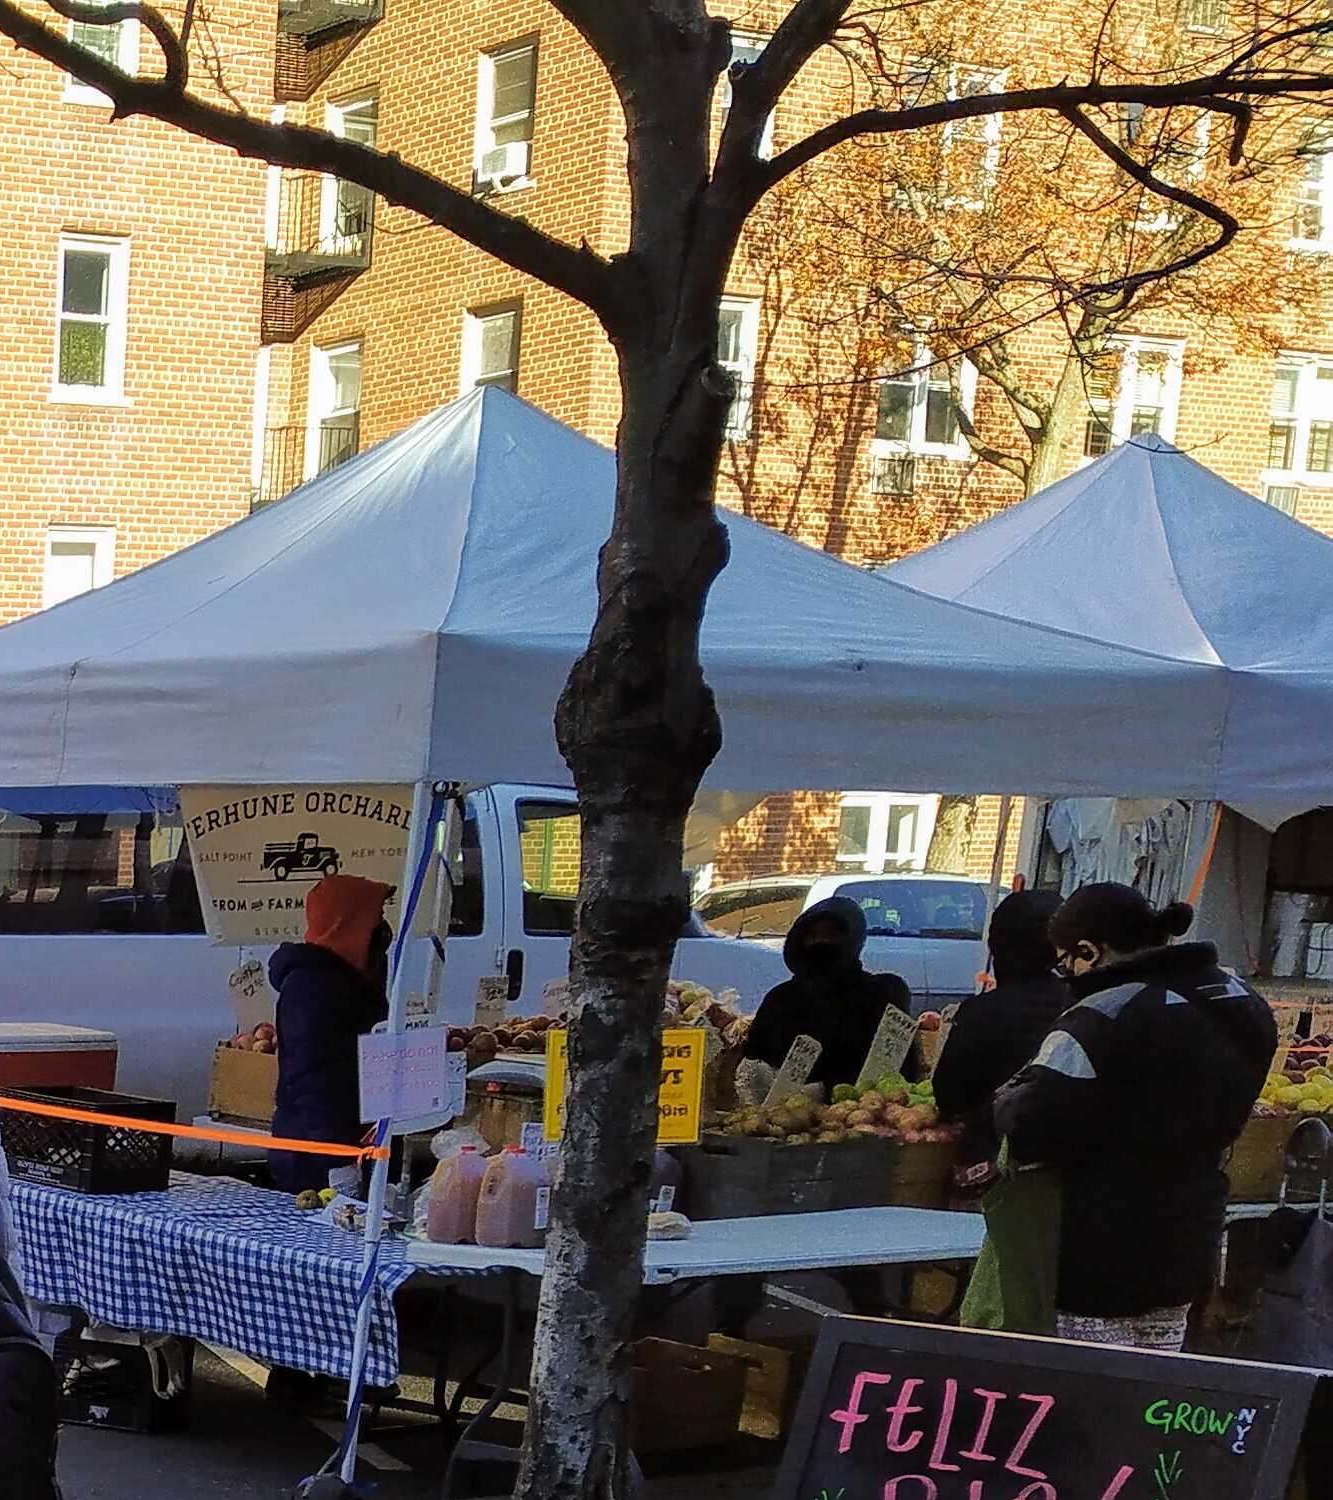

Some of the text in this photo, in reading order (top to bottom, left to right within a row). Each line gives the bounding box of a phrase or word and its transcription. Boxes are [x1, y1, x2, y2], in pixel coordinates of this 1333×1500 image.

[186, 793, 295, 839] ERHUNE
[199, 852, 252, 863] SALT POINT
[829, 1371, 1054, 1479] FELIZ
[1145, 1399, 1234, 1435] GROW
